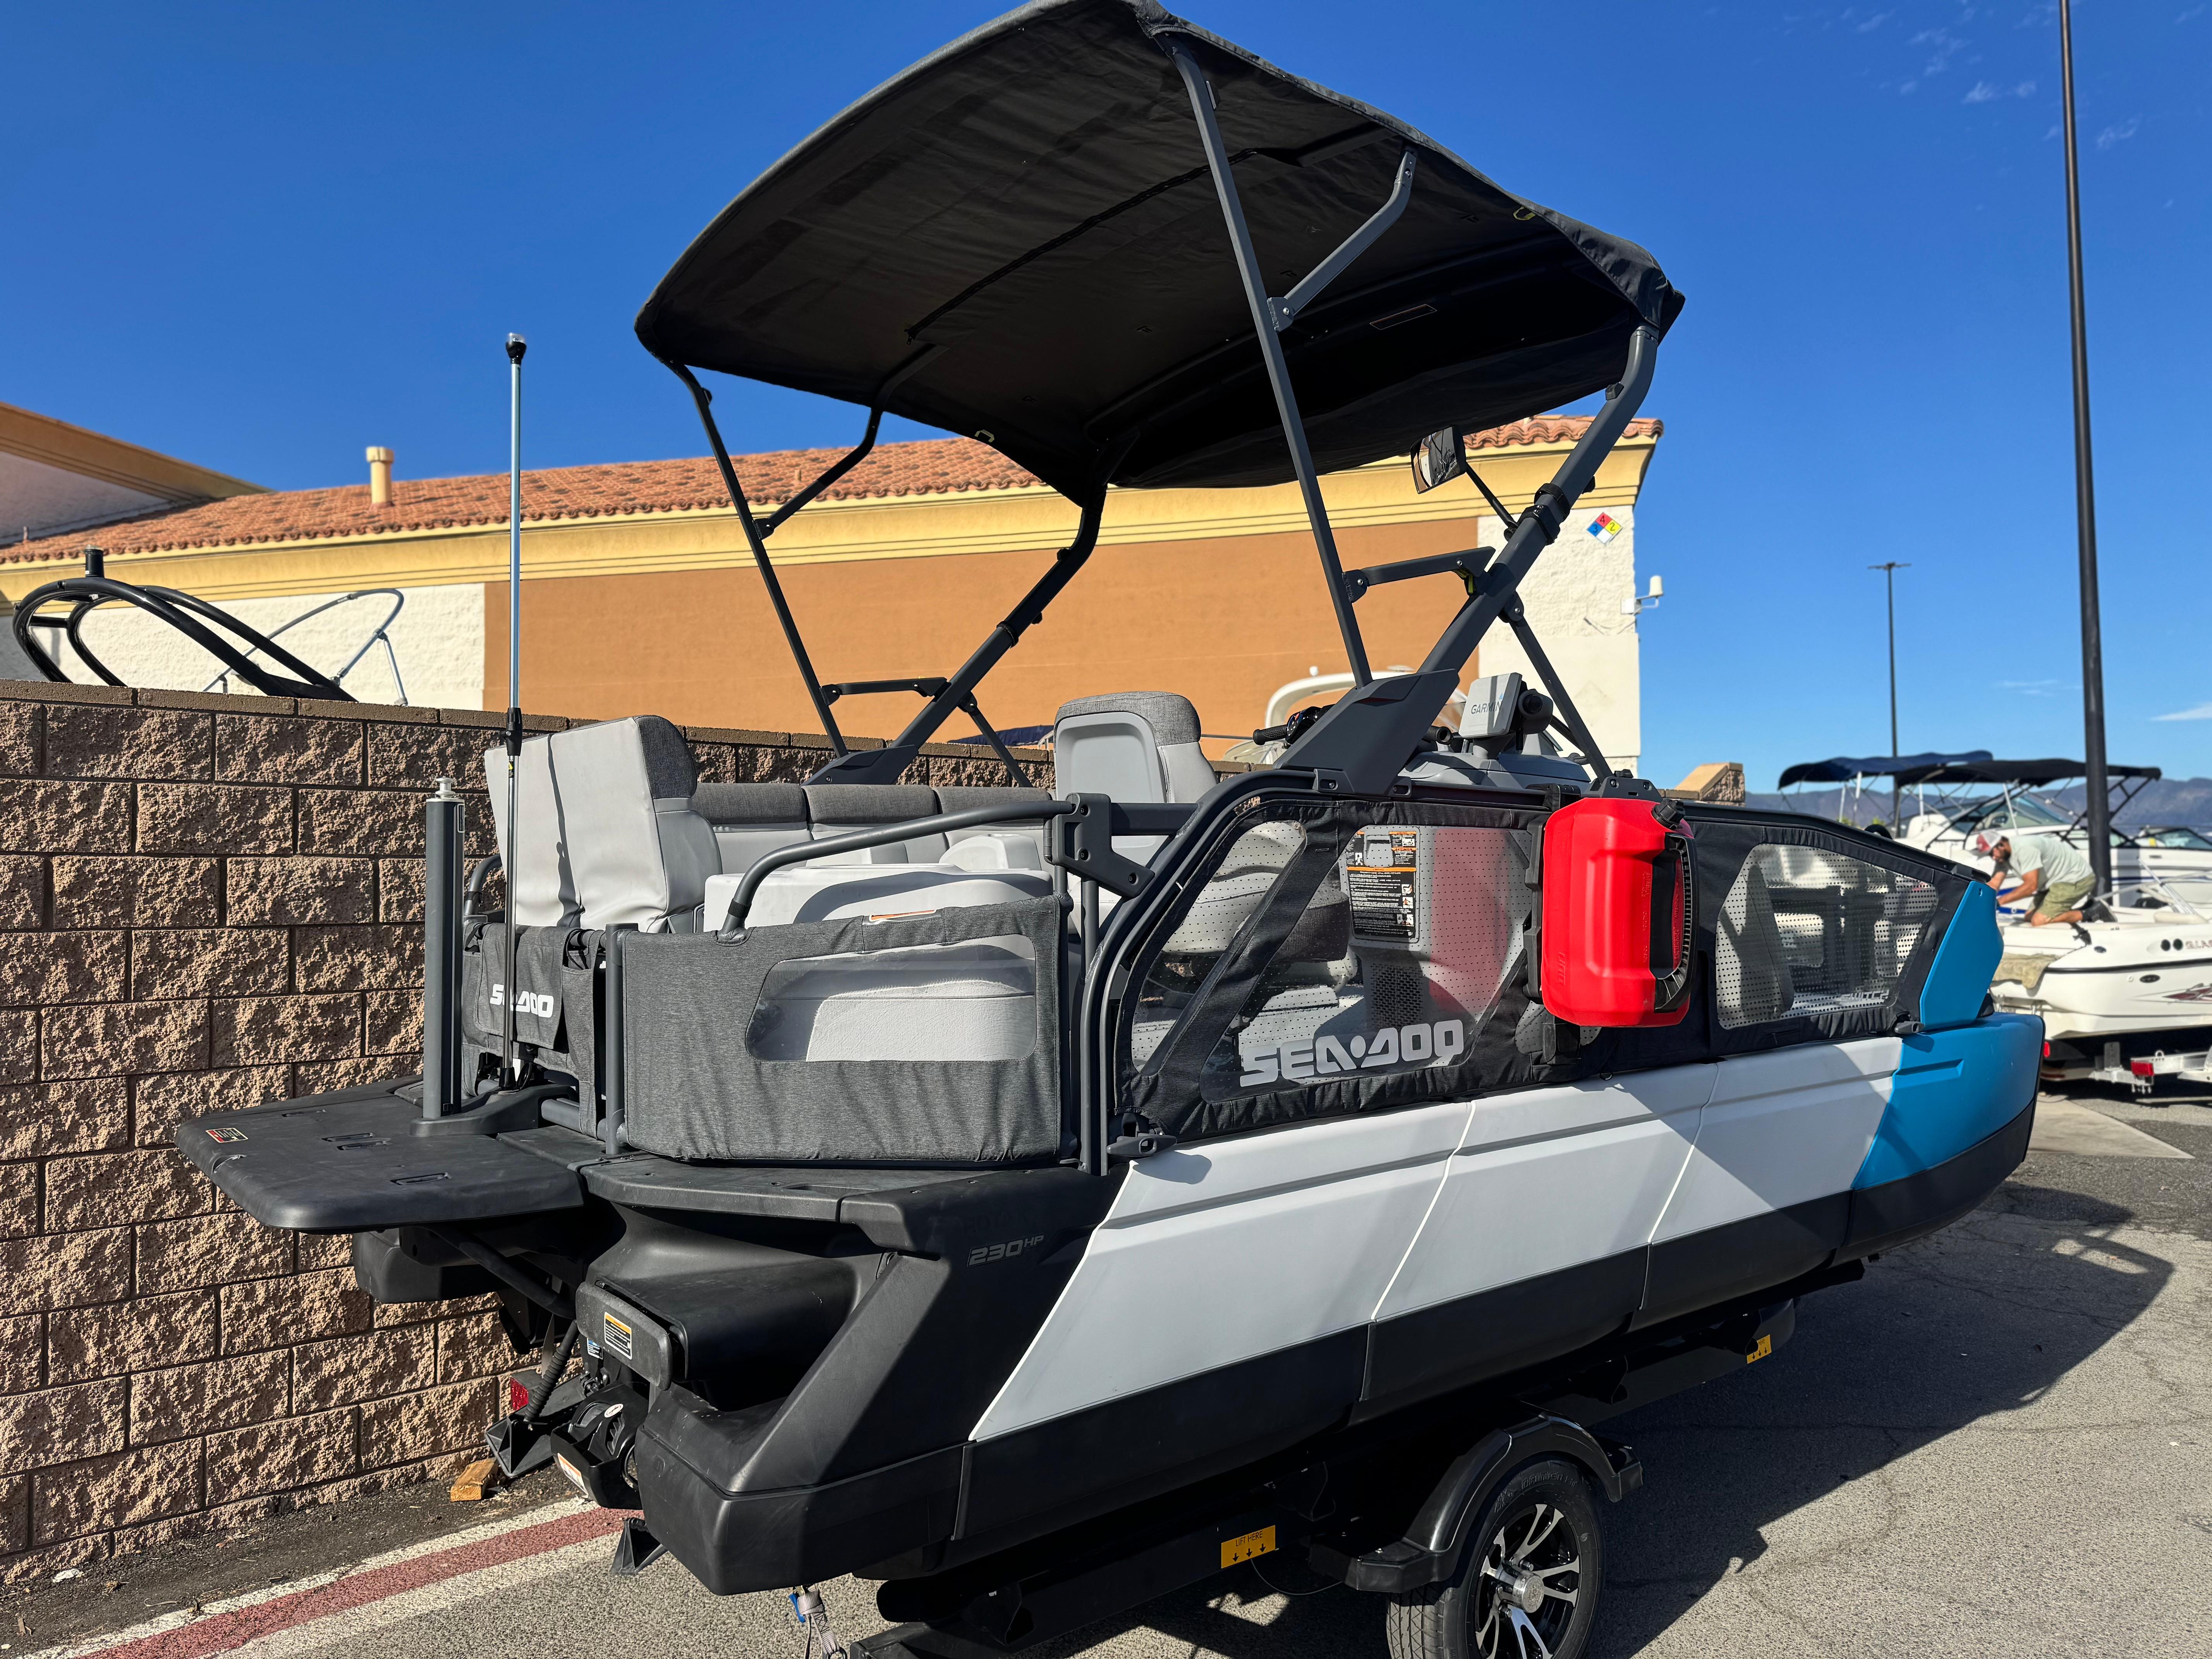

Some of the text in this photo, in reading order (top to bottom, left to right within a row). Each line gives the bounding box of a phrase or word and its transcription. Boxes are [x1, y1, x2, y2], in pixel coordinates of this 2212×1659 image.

[1600, 516, 1606, 524] 4
[1592, 524, 1599, 533] 3
[1610, 522, 1616, 531] 2
[1471, 701, 1501, 714] GARMIN
[1838, 989, 1889, 1001] SWITCH
[1235, 1530, 1263, 1546] LIFT HERE
